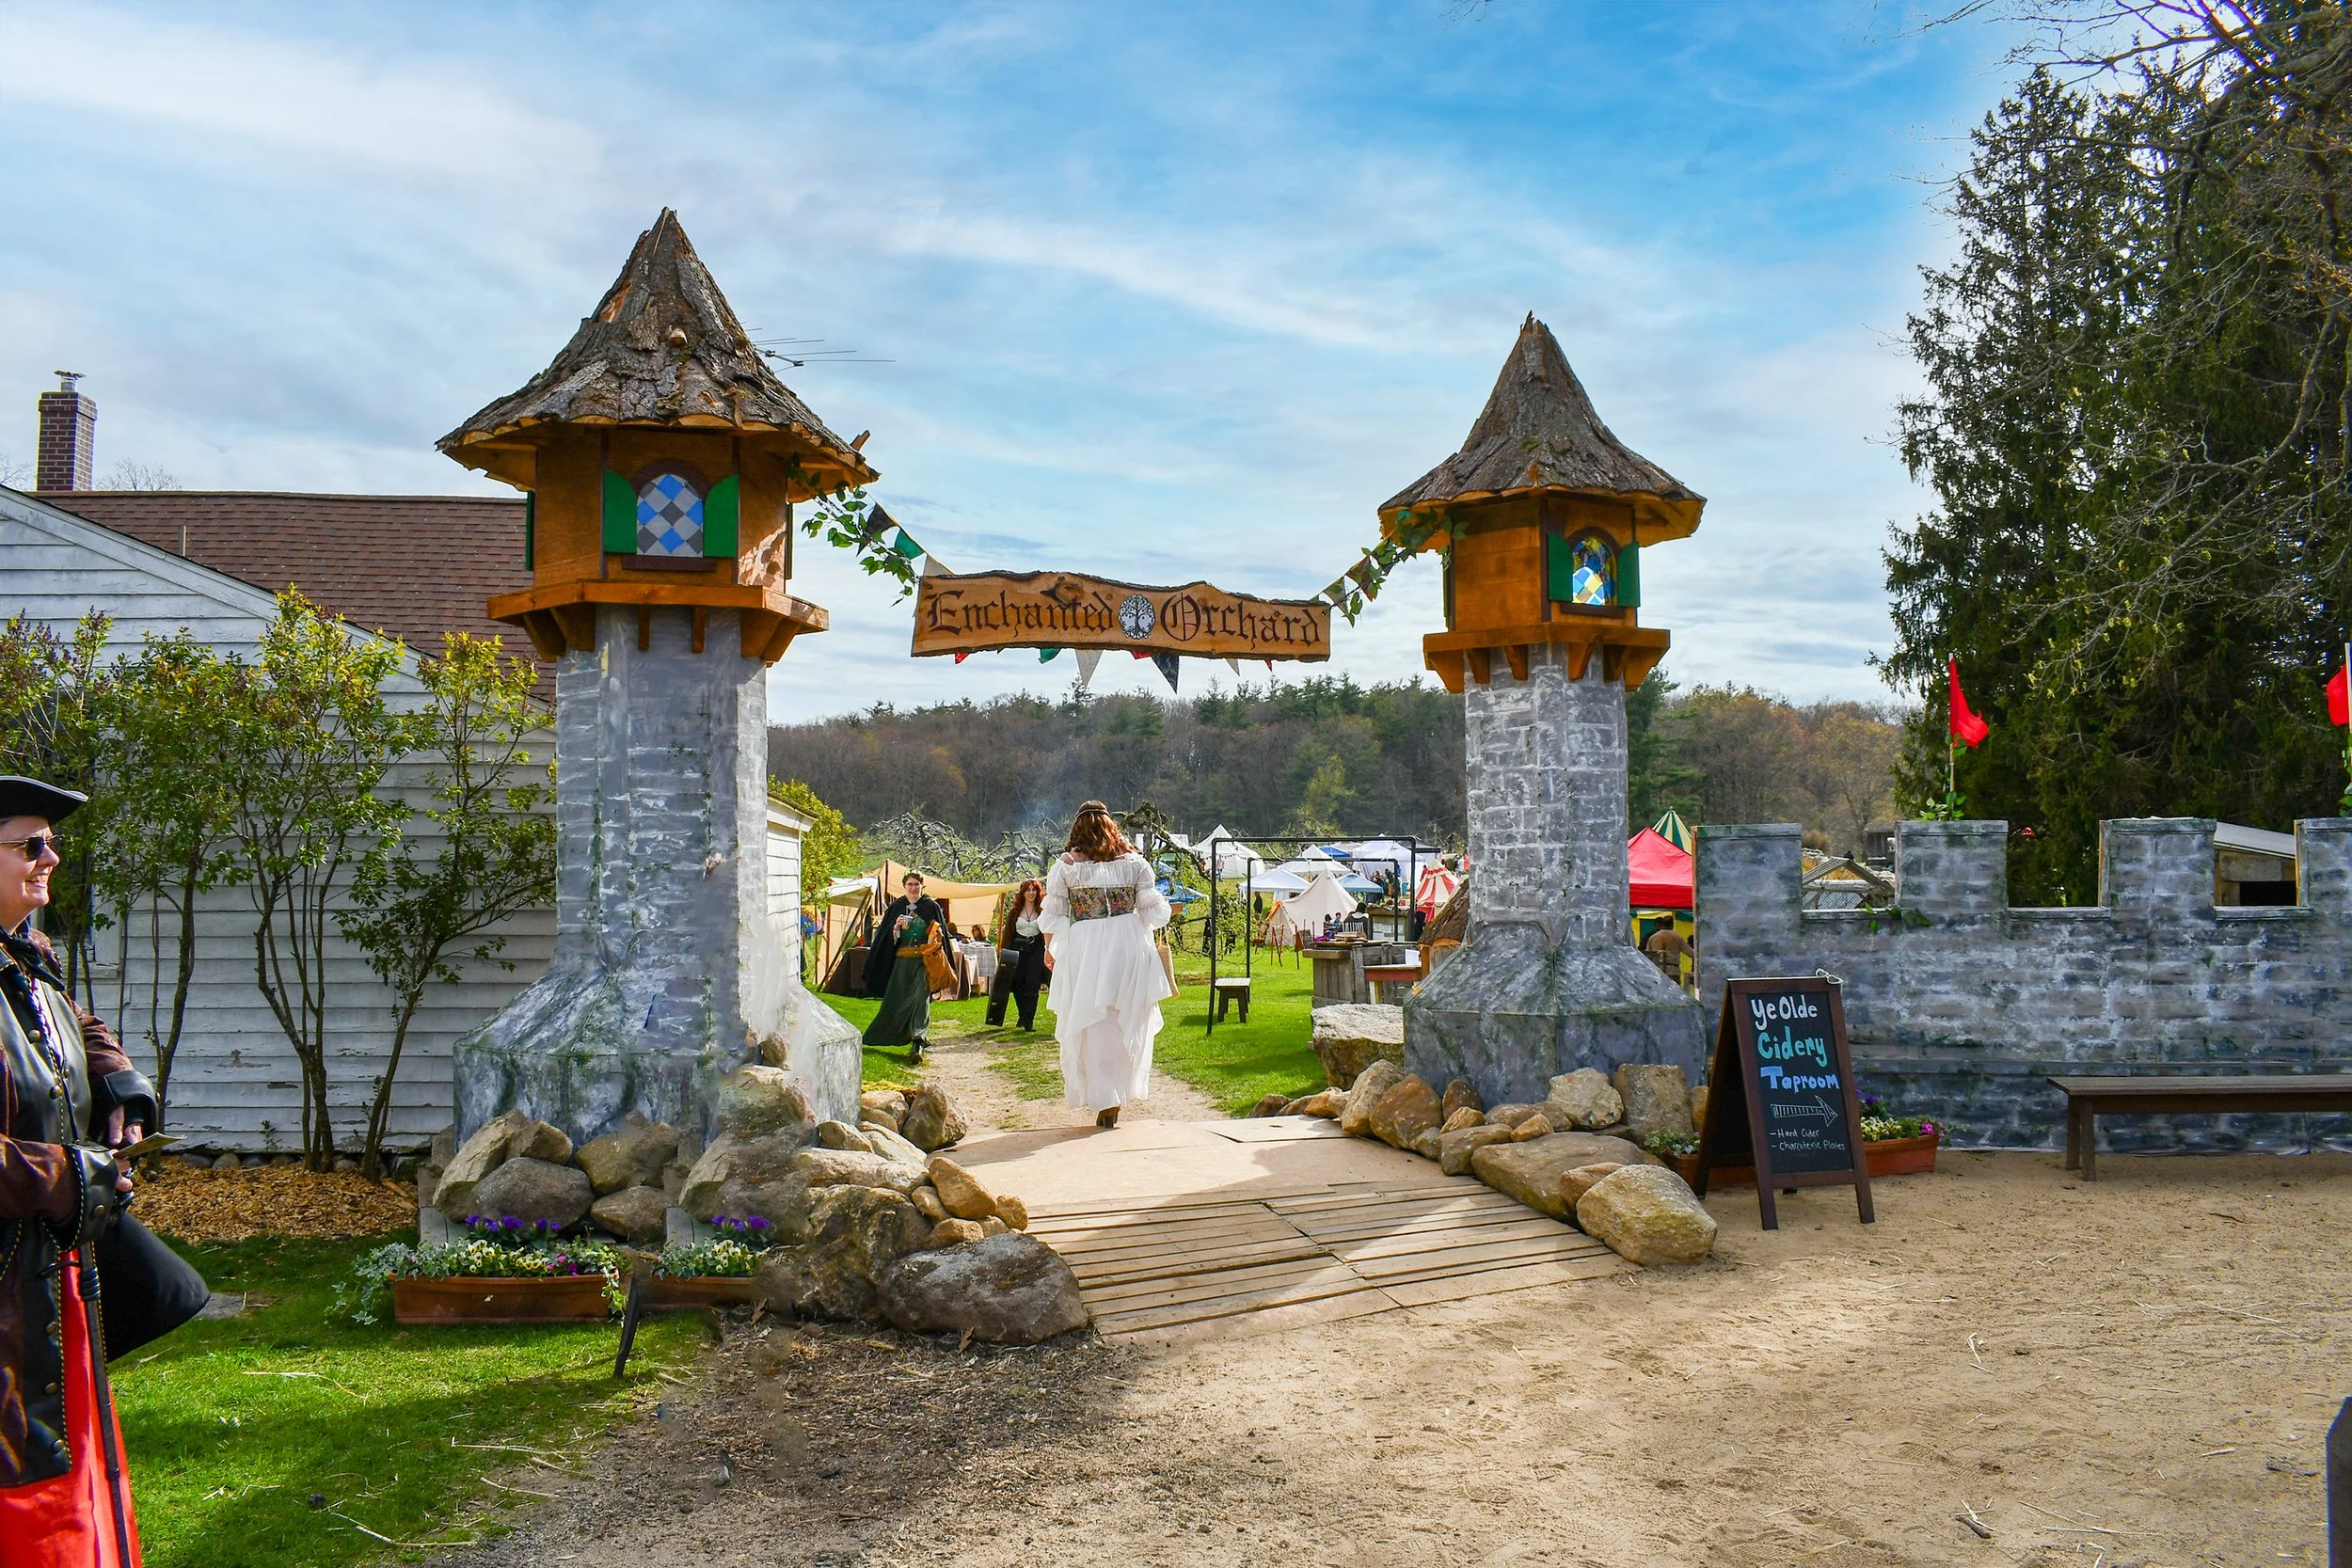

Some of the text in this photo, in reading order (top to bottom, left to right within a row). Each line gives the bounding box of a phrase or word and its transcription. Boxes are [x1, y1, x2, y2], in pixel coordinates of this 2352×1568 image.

[928, 590, 1321, 650] Enchanted Orchard
[1779, 994, 1818, 1020] Olde
[1757, 1025, 1828, 1067] Cidery
[1760, 1066, 1839, 1093] Taproom
[1801, 1129, 1820, 1137] Cider
[1822, 1140, 1845, 1149] Plates
